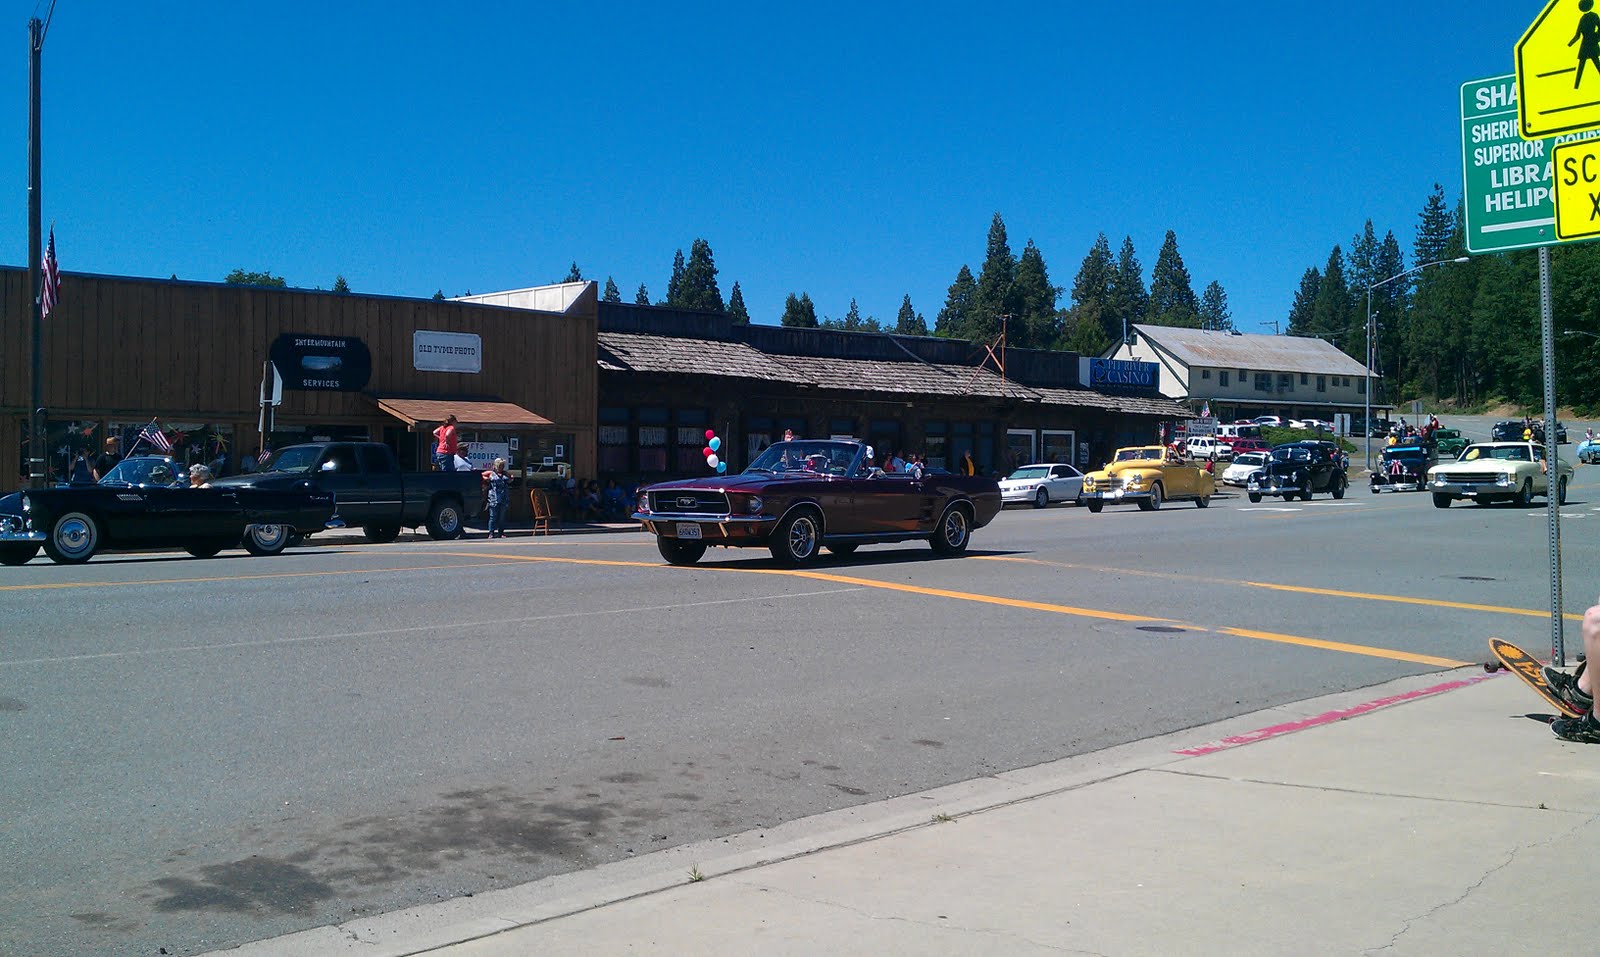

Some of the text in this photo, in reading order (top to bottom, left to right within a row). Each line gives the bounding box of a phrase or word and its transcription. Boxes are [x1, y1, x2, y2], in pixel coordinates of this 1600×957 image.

[1474, 139, 1544, 167] SUPERIOR
[1490, 161, 1553, 189] LIBRA
[1564, 153, 1597, 186] SC
[295, 339, 346, 348] INTERMOUNTAIN
[418, 344, 476, 355] OLD TYME PHOTO
[1124, 361, 1149, 372] RIVER
[1107, 370, 1150, 384] CASINO
[302, 379, 340, 388] SERVICES
[468, 452, 500, 460] GOODIES
